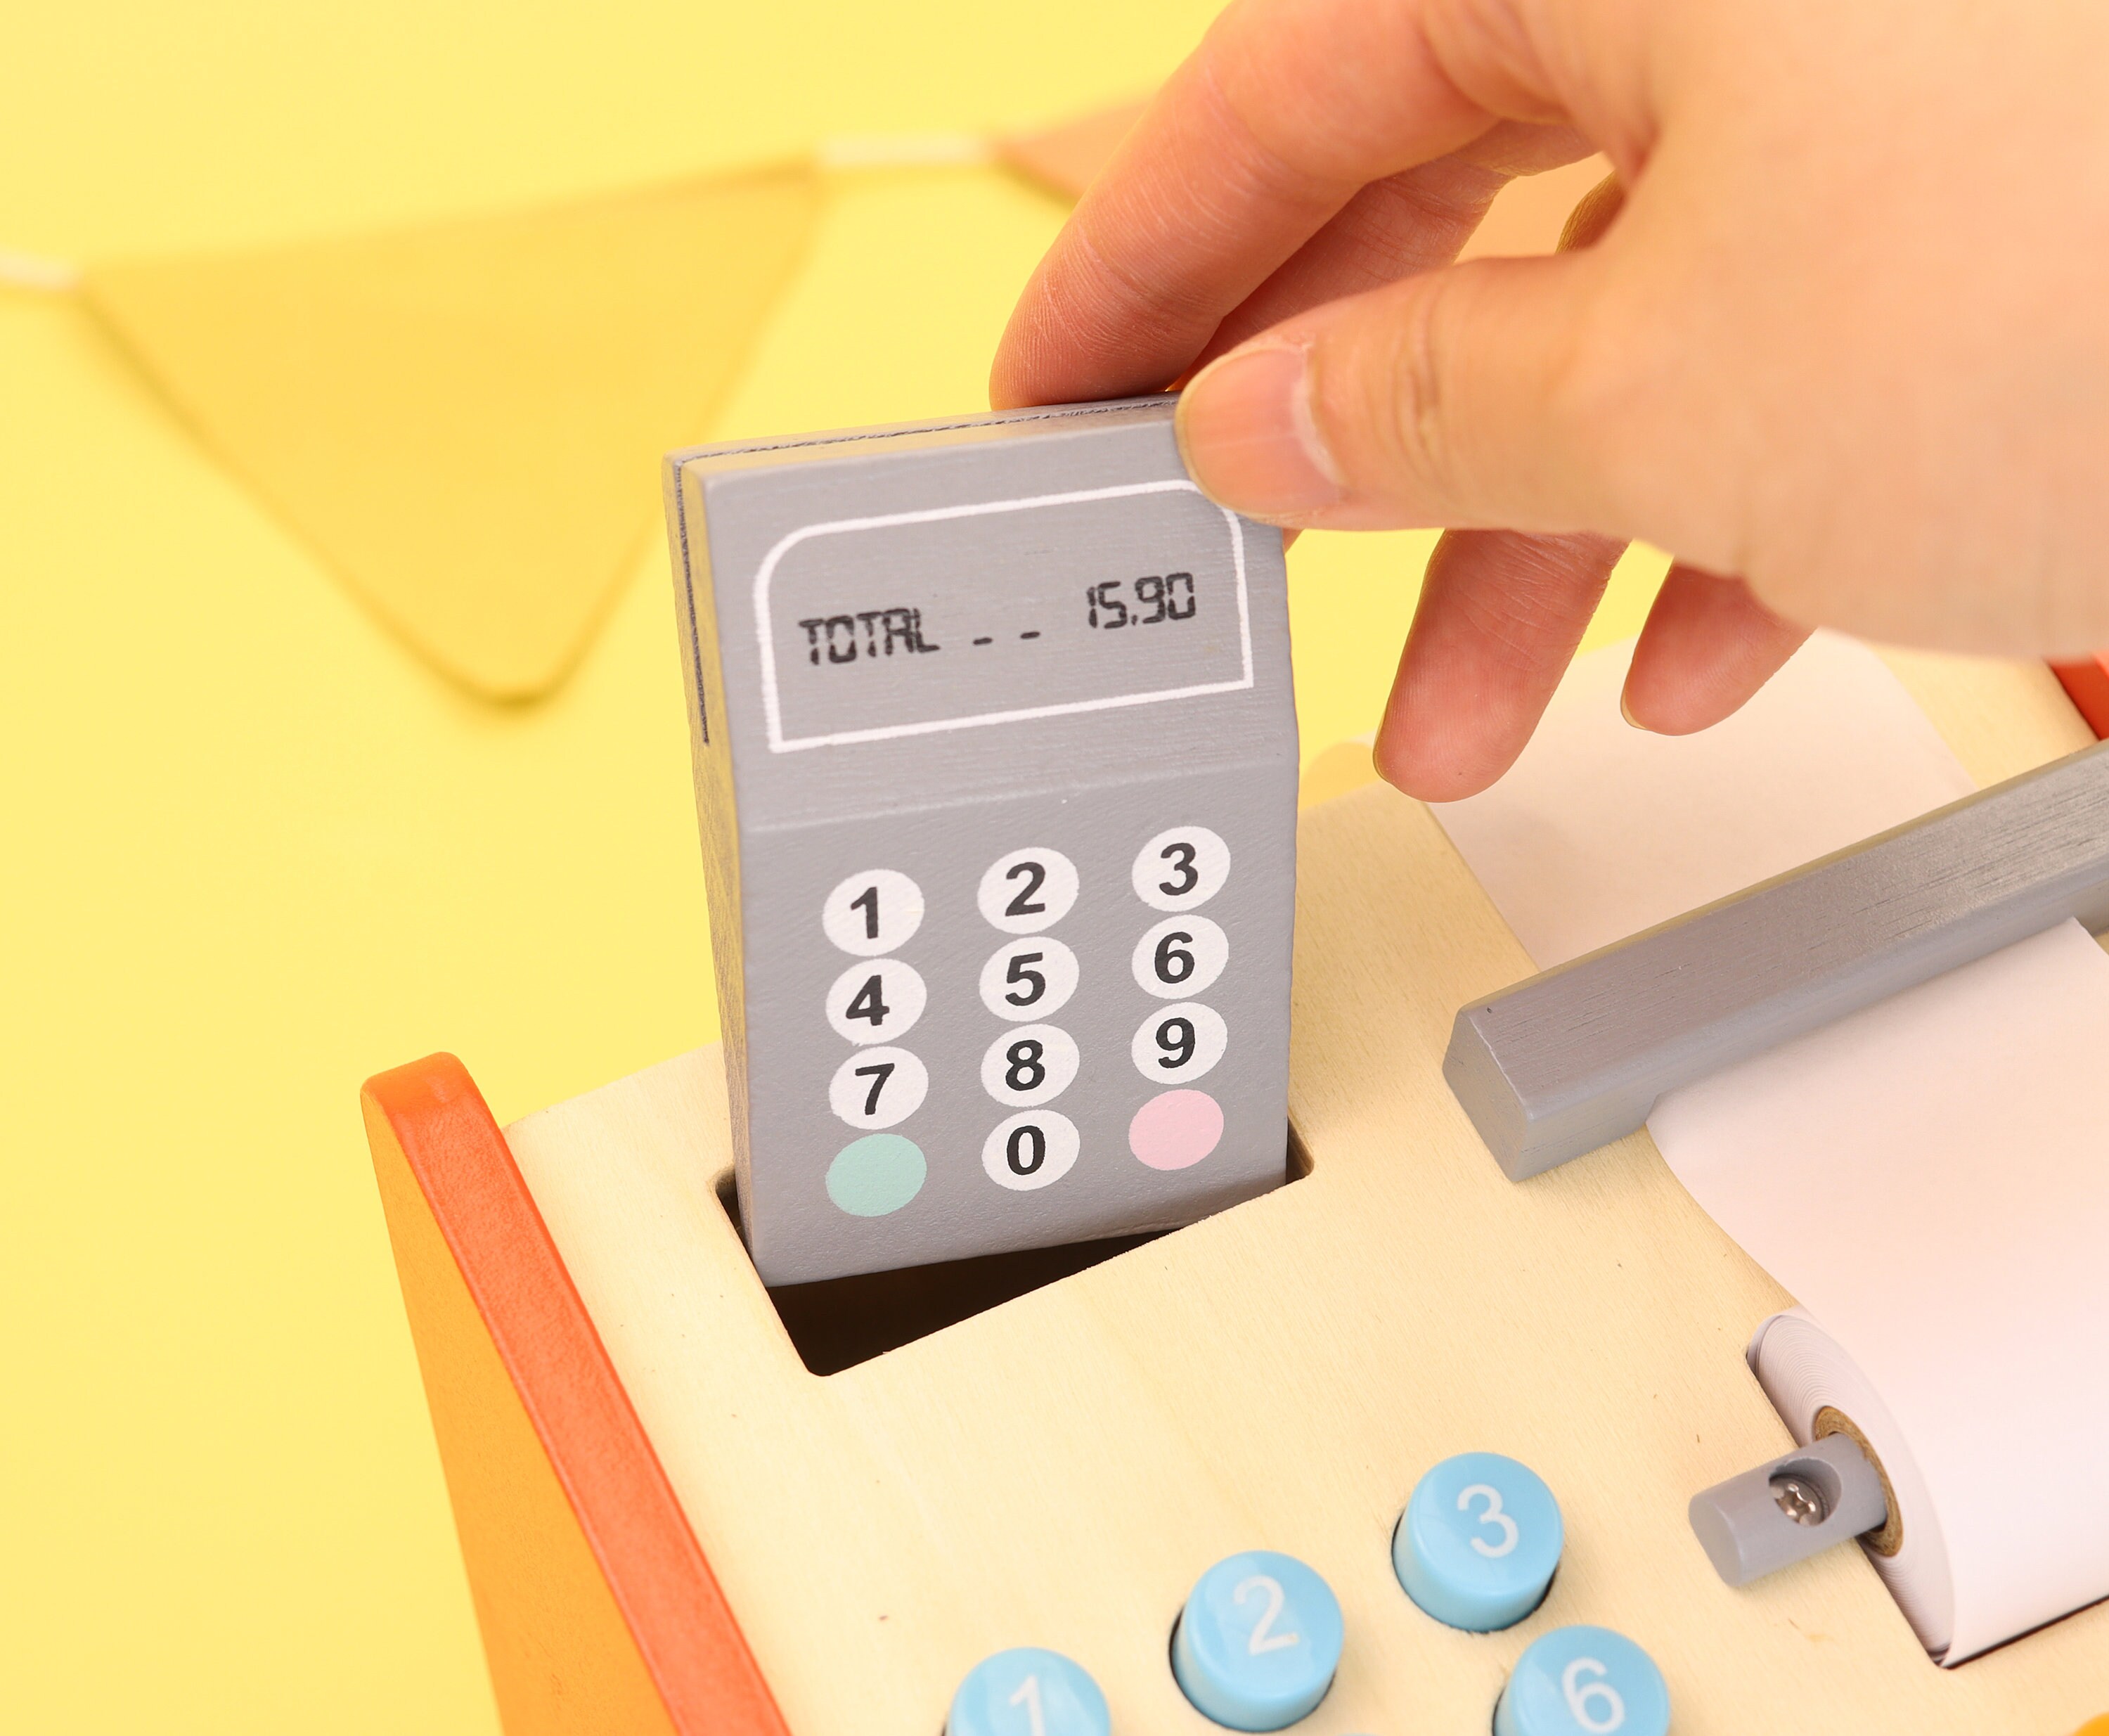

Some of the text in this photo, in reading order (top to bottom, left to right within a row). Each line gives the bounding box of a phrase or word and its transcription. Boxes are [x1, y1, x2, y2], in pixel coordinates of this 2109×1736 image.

[799, 608, 939, 664] TOTAL
[851, 842, 1197, 938] 1 2 3
[846, 932, 1194, 1025] 4 5 6
[855, 1017, 1195, 1114] 7 8 9
[1006, 1125, 1045, 1175] 0
[1009, 1484, 1519, 1736] 1 2 3
[1561, 1657, 1626, 1735] 6
